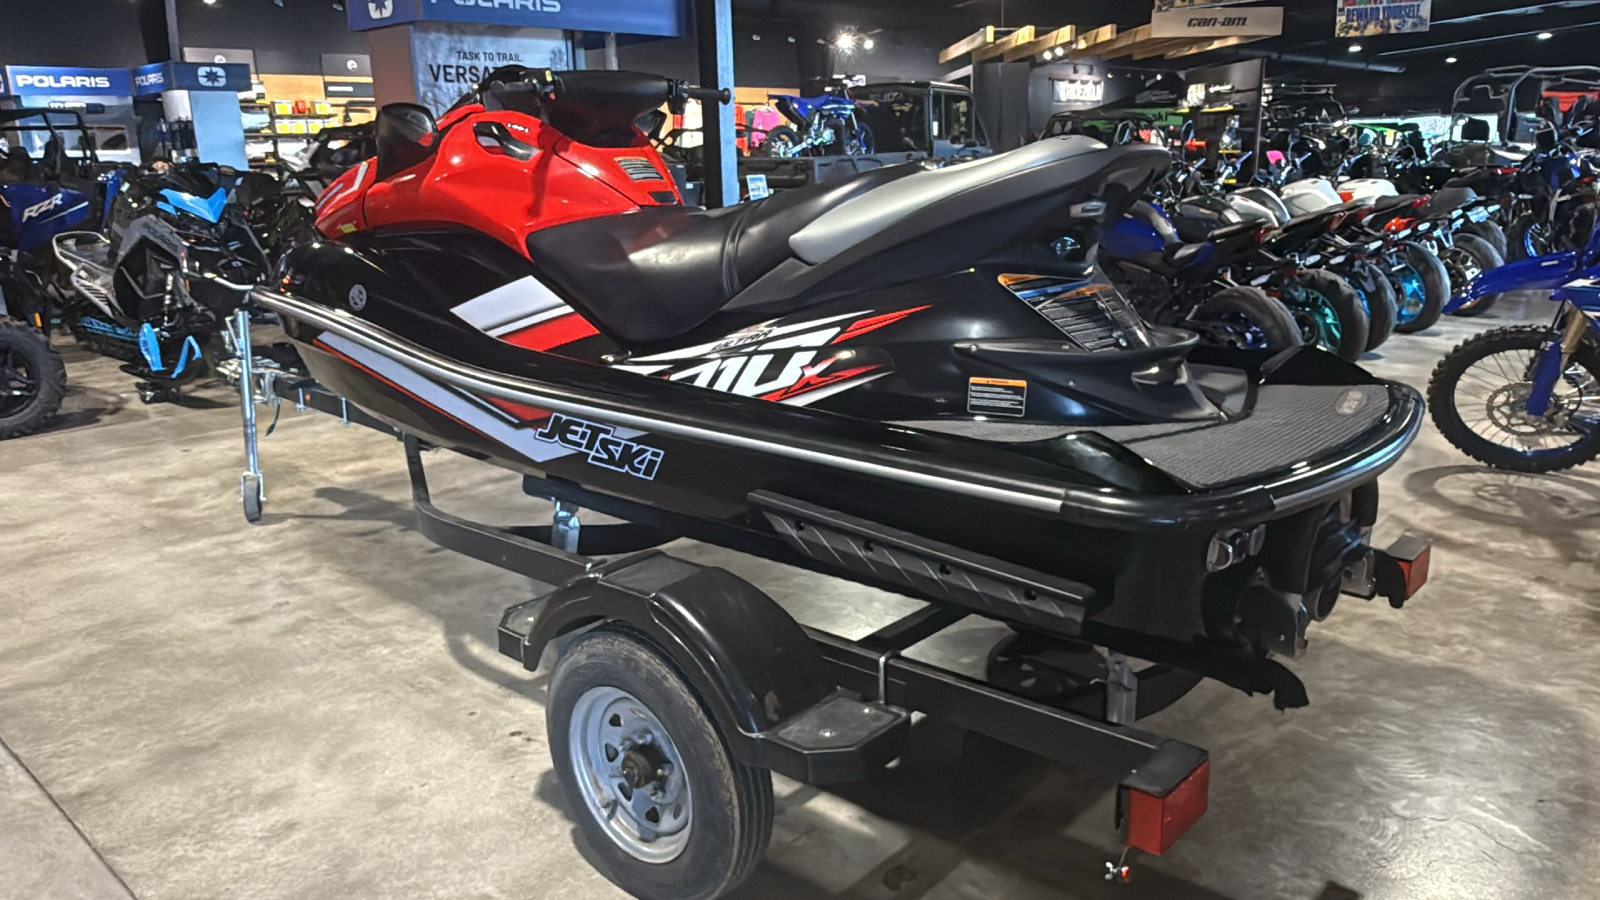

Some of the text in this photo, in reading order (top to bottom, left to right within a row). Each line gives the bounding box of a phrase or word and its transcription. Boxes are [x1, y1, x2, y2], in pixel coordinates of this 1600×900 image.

[456, 51, 522, 62] TASK TO TRAIL
[15, 74, 110, 88] POLARIS
[135, 72, 164, 87] POLARIS
[22, 193, 63, 223] RZR
